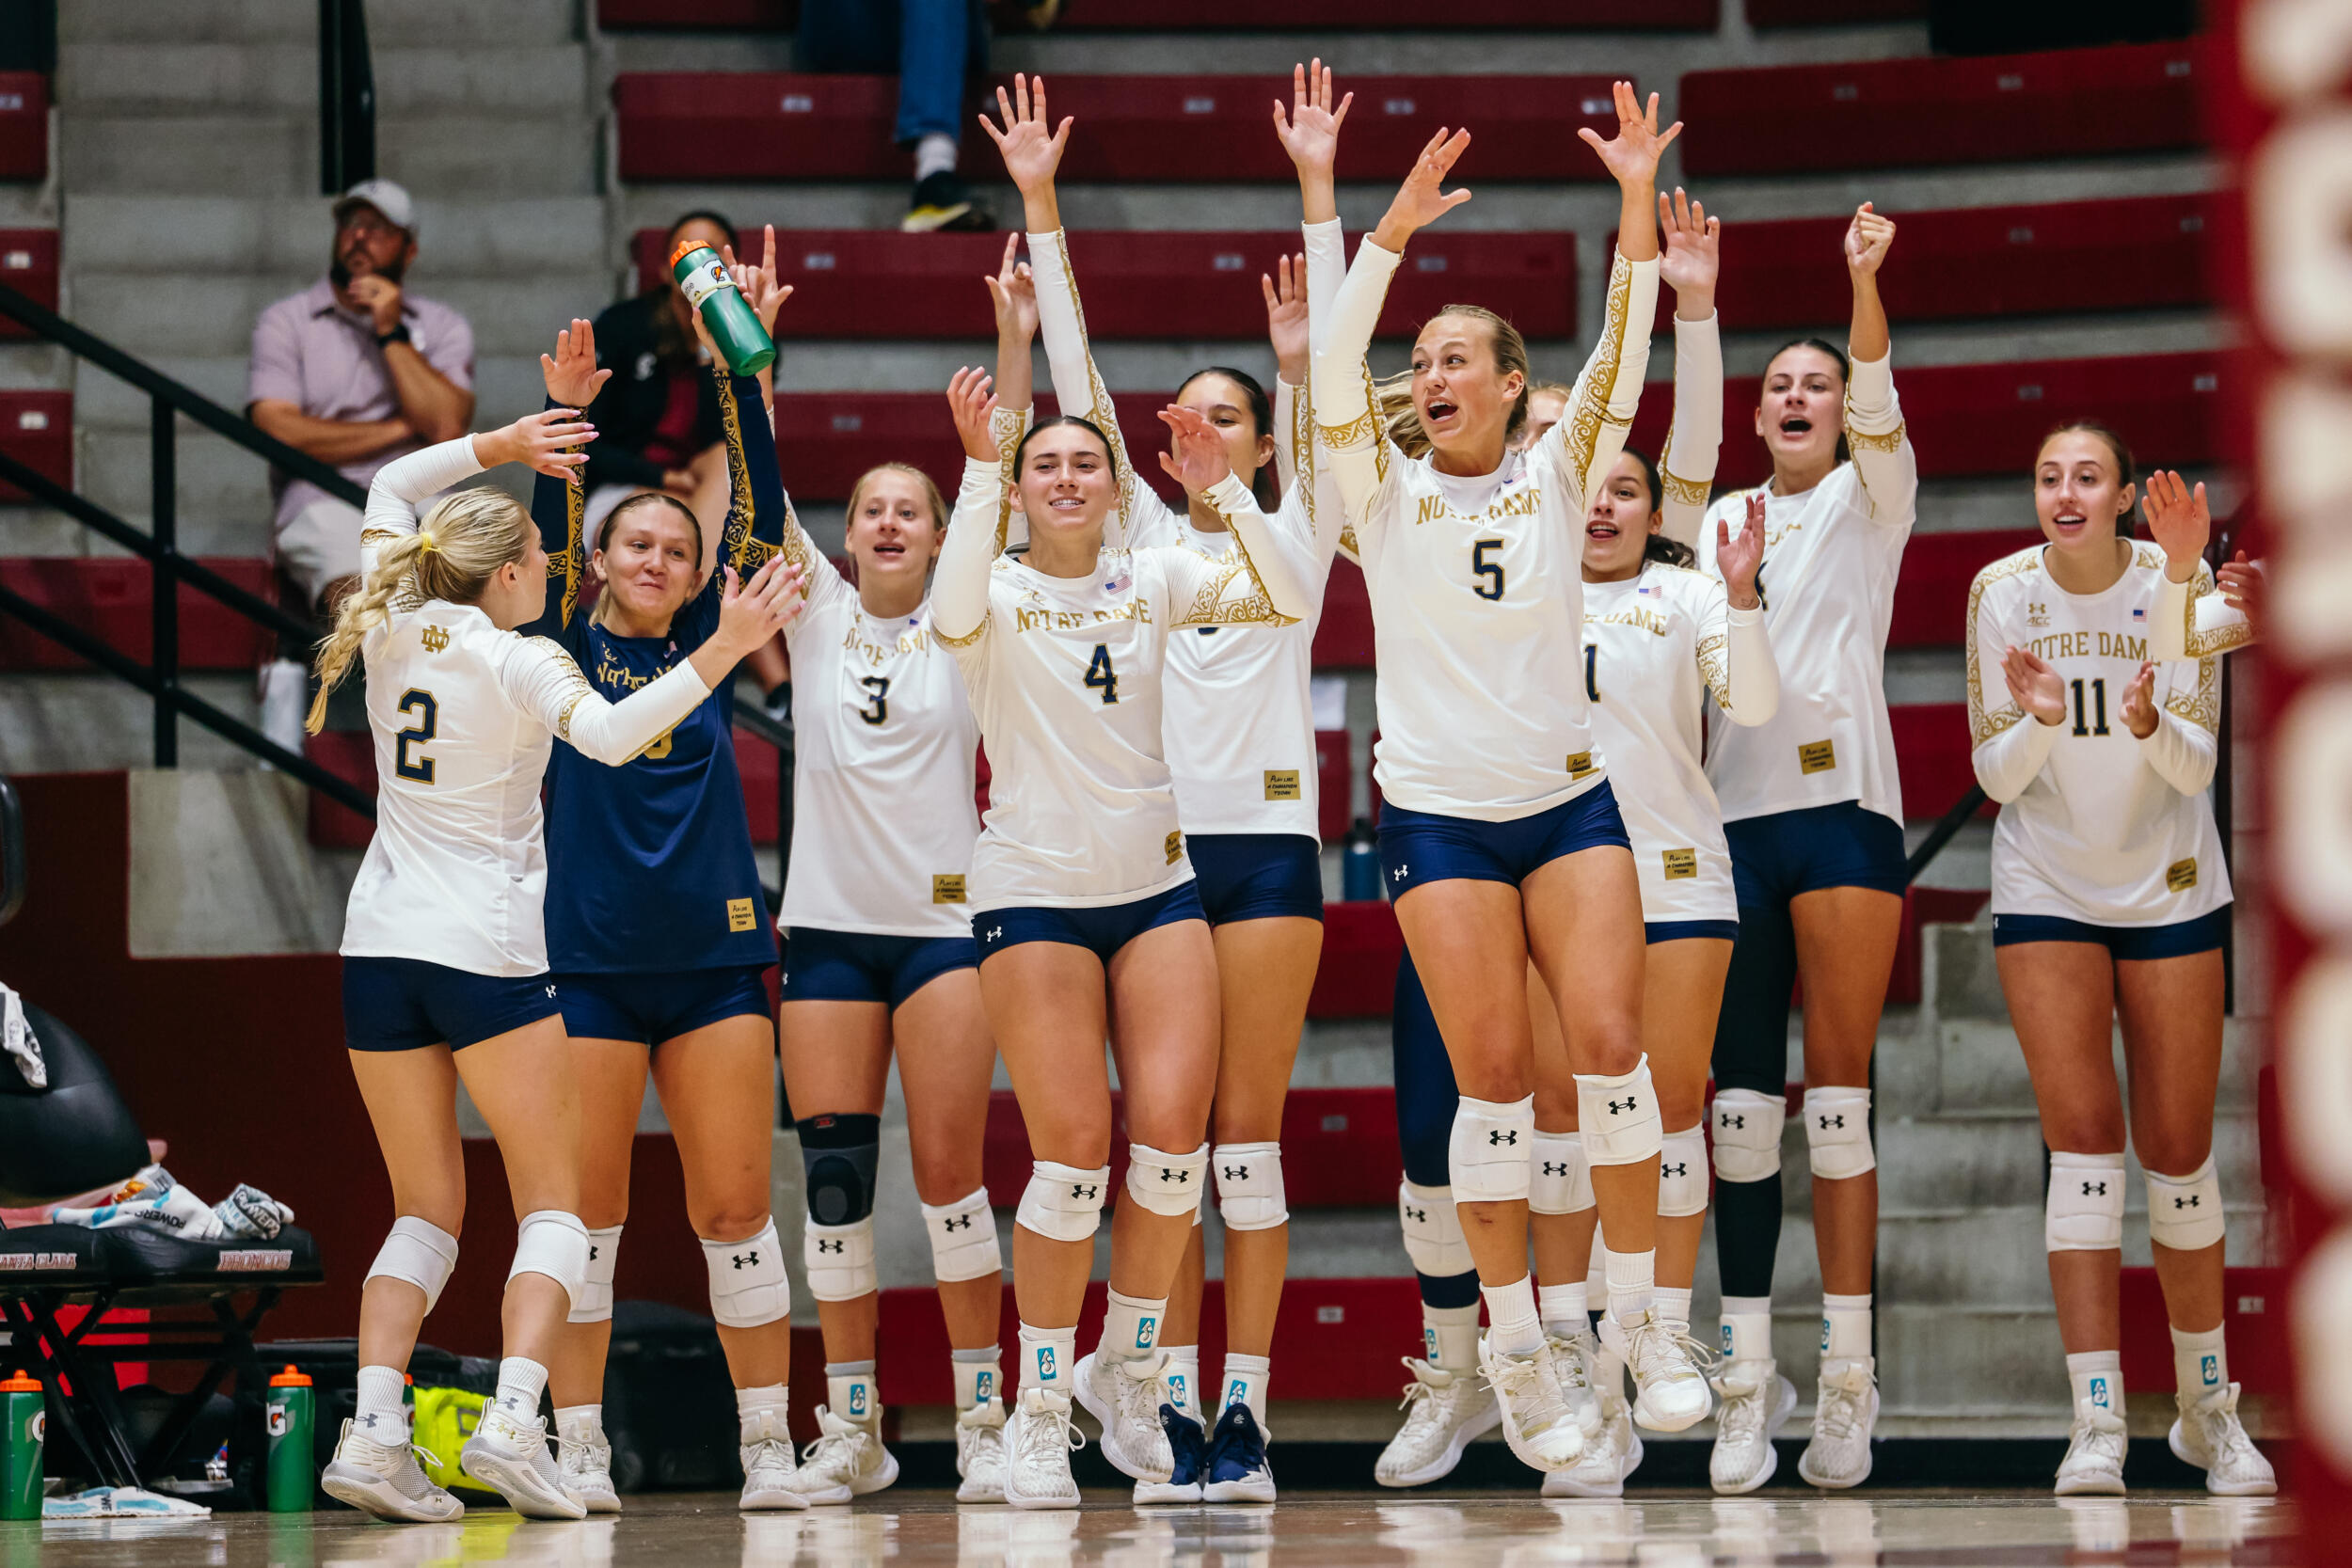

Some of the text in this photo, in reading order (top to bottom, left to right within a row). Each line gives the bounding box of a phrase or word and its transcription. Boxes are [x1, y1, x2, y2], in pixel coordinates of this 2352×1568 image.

[1472, 538, 1505, 602] 5
[1083, 642, 1120, 705] 4
[2024, 631, 2161, 669] OTRE DAM
[859, 675, 890, 726] 3
[2071, 678, 2111, 737] 11
[395, 688, 439, 785] 2
[0, 1253, 34, 1270] ANTA
